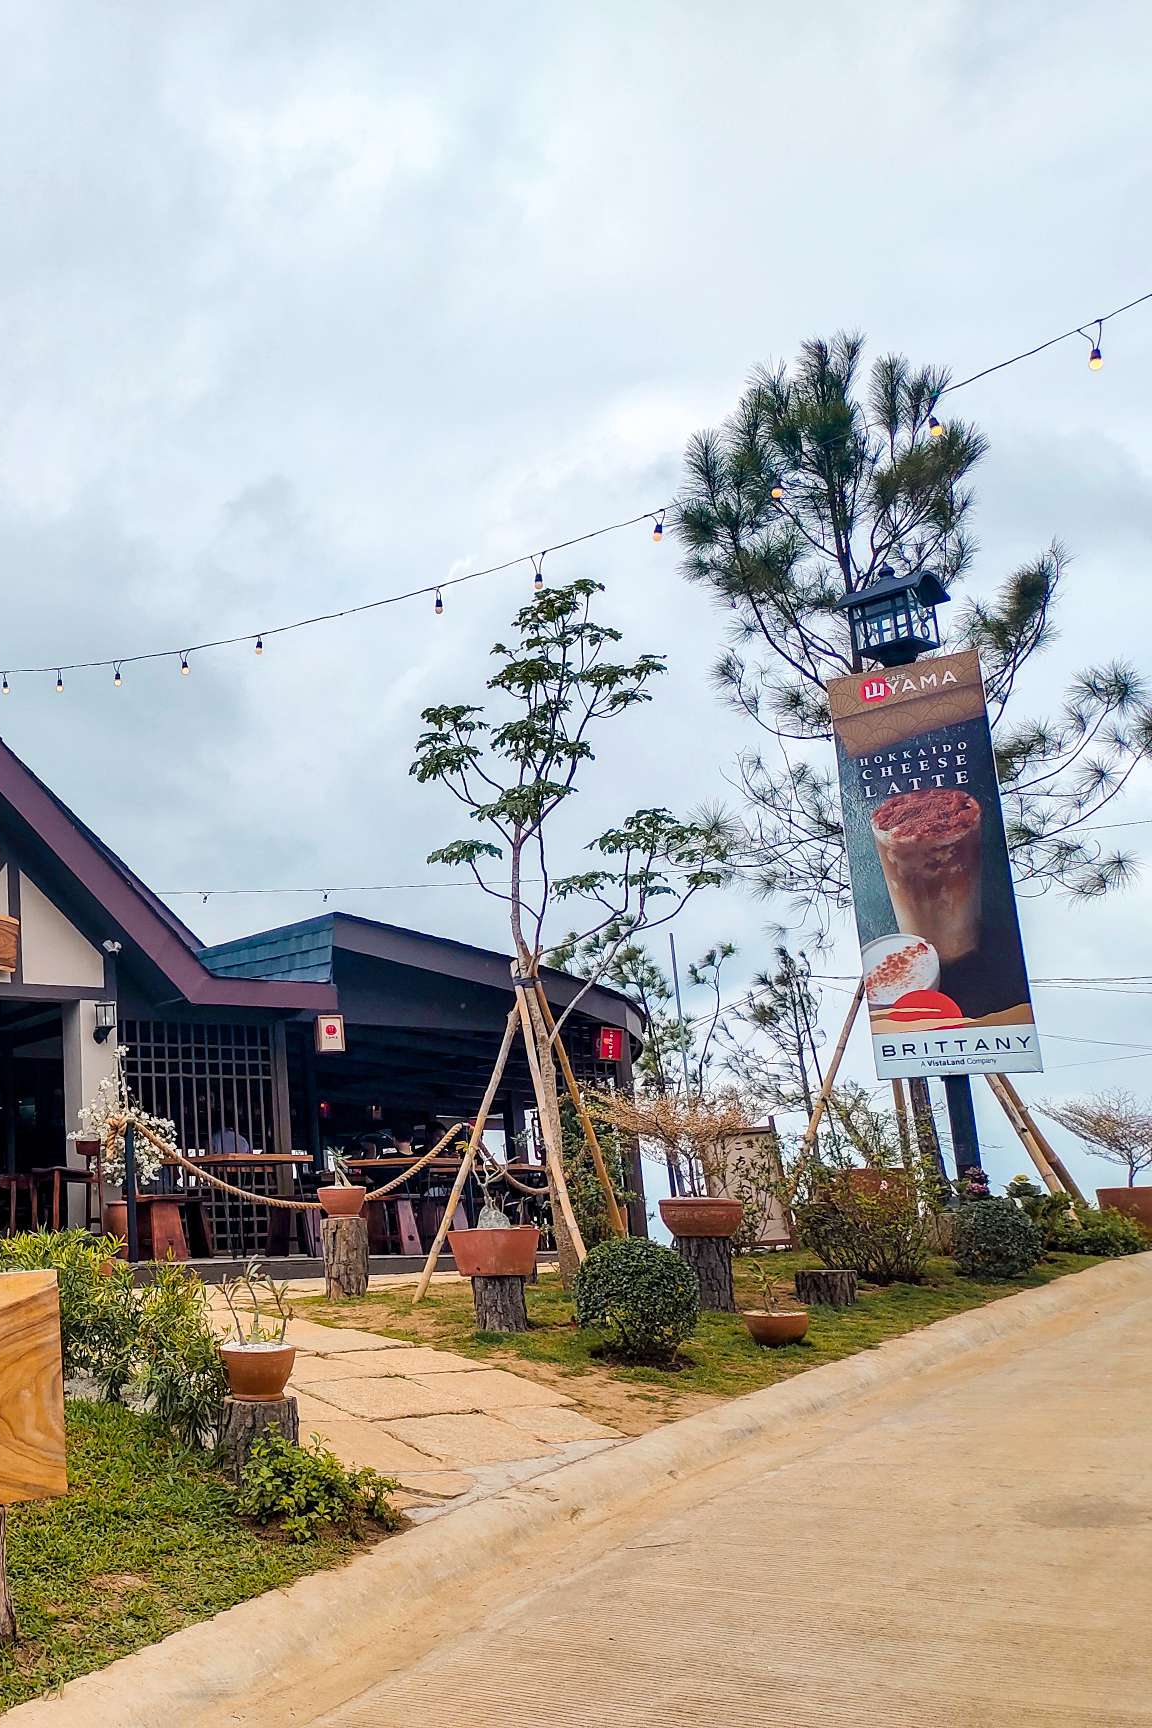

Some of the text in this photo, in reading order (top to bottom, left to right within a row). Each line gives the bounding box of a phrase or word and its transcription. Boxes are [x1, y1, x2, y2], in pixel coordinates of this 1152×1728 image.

[885, 673, 906, 683] CAFE
[885, 670, 958, 695] YAMA
[859, 741, 967, 767] HOKKAIDO
[861, 754, 967, 780] CHEESE
[864, 770, 969, 798] LATTE
[881, 1035, 1031, 1057] BRITTANY
[928, 1058, 965, 1067] VistaLand
[967, 1057, 997, 1066] Company
